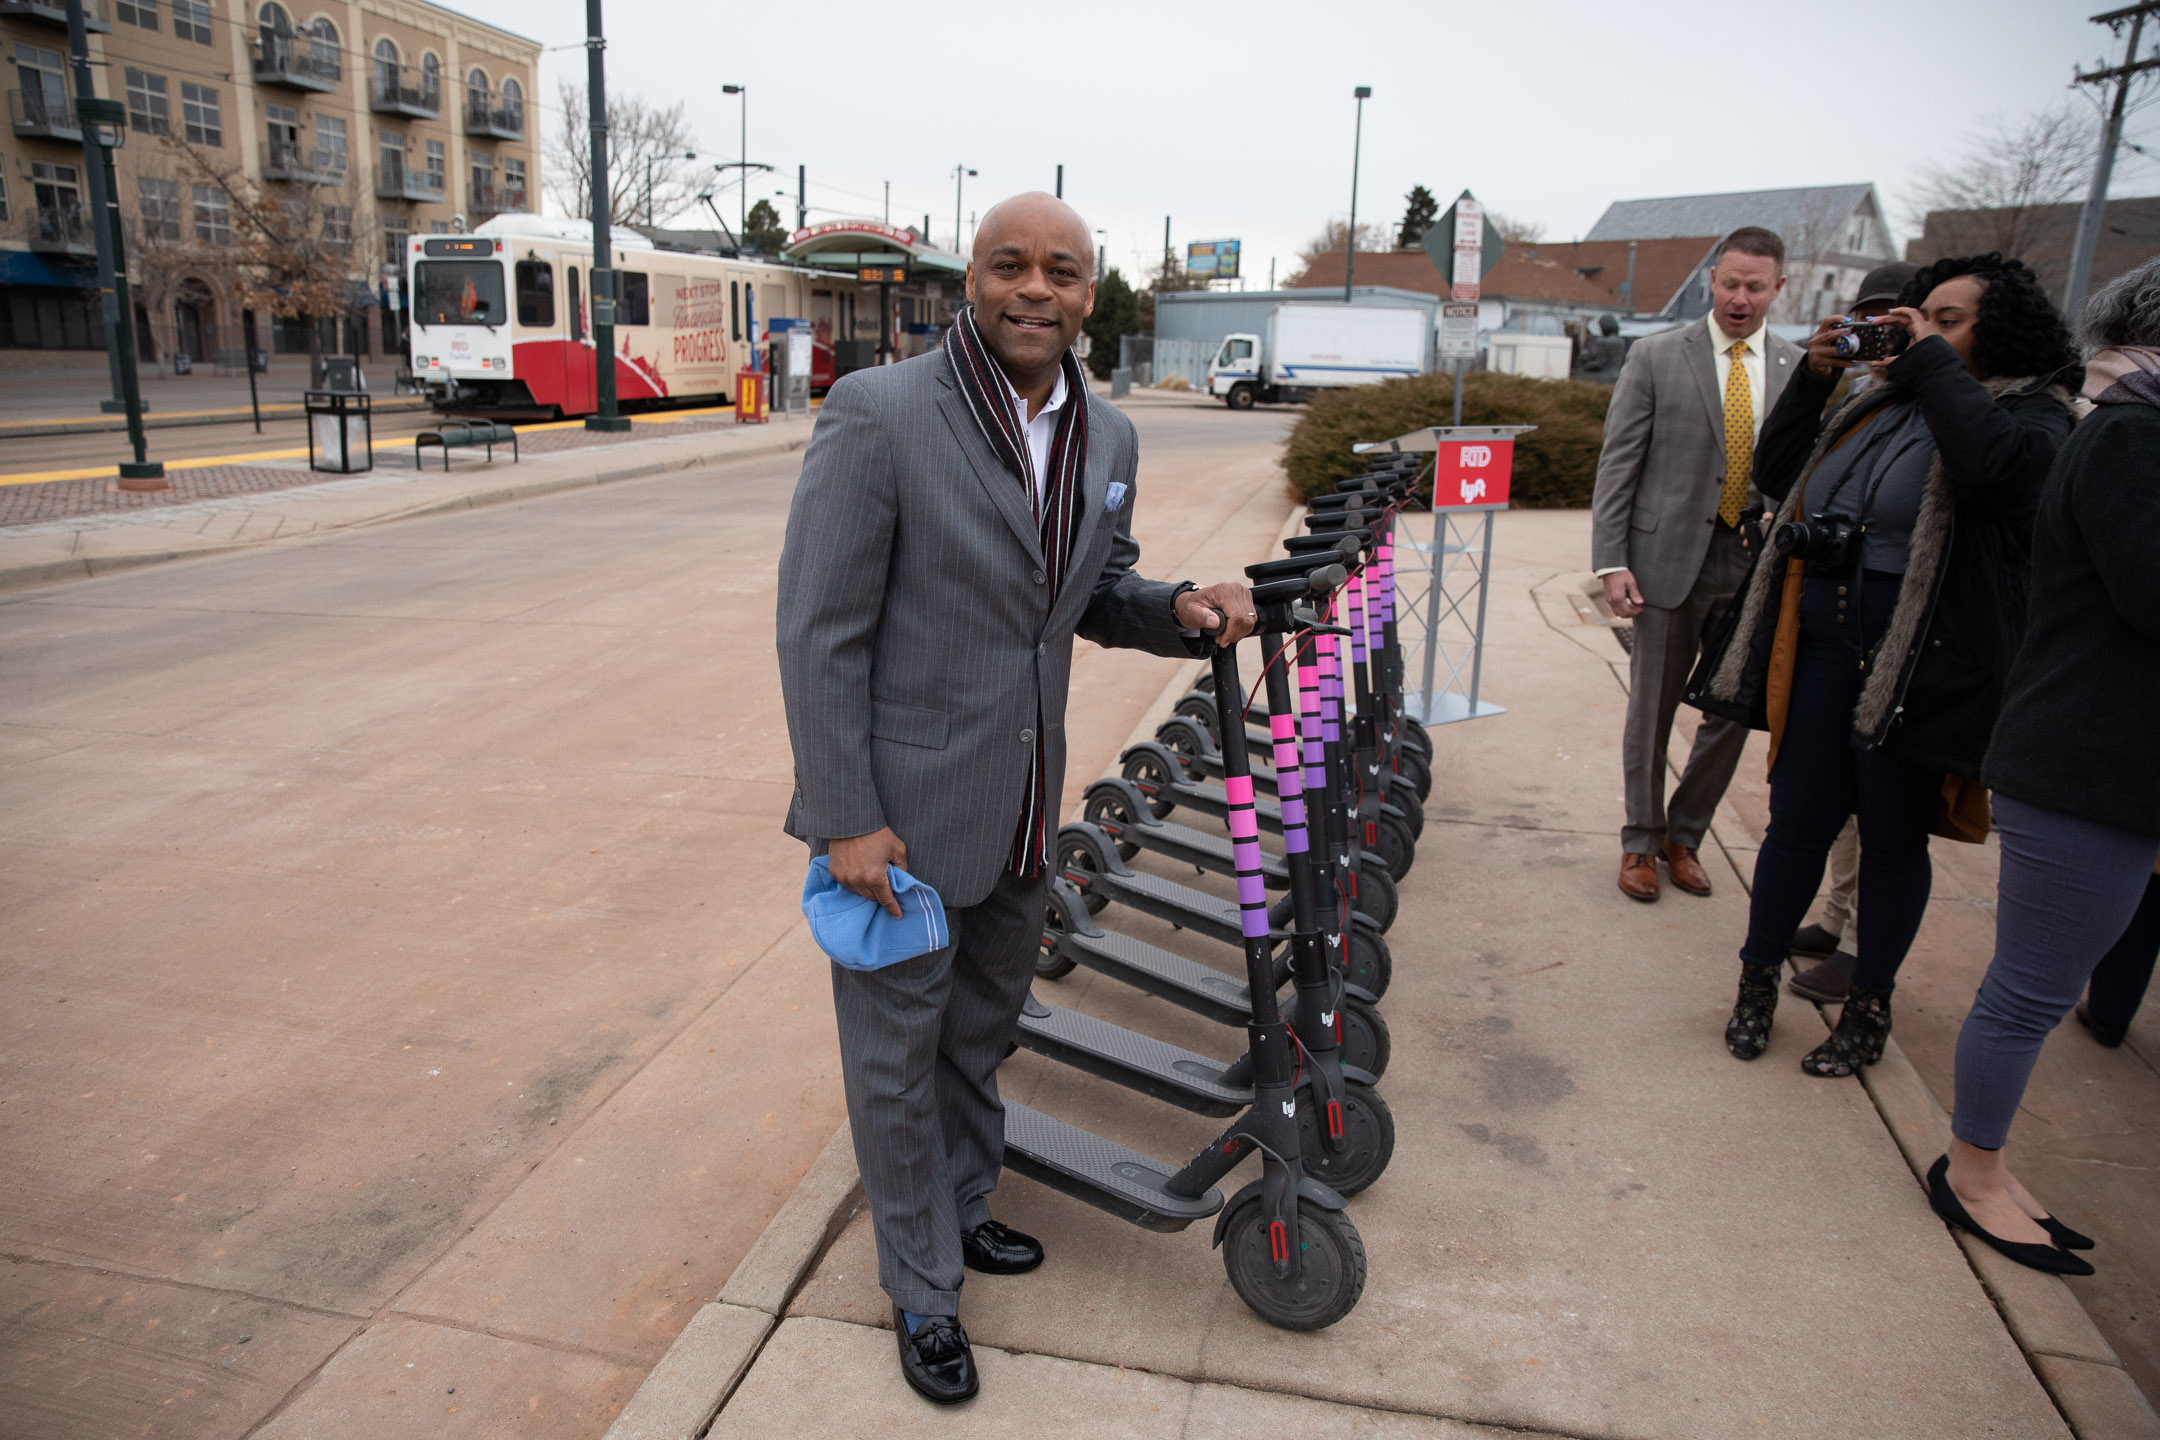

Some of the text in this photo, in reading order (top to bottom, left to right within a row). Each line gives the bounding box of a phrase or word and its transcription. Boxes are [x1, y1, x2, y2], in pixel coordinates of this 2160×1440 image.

[676, 283, 721, 300] NEXT STOP
[1445, 306, 1475, 318] NOTICE
[674, 328, 726, 362] PROGRESS
[1460, 445, 1491, 467] RTD
[1461, 478, 1486, 503] lyft
[1282, 1097, 1296, 1118] ly
